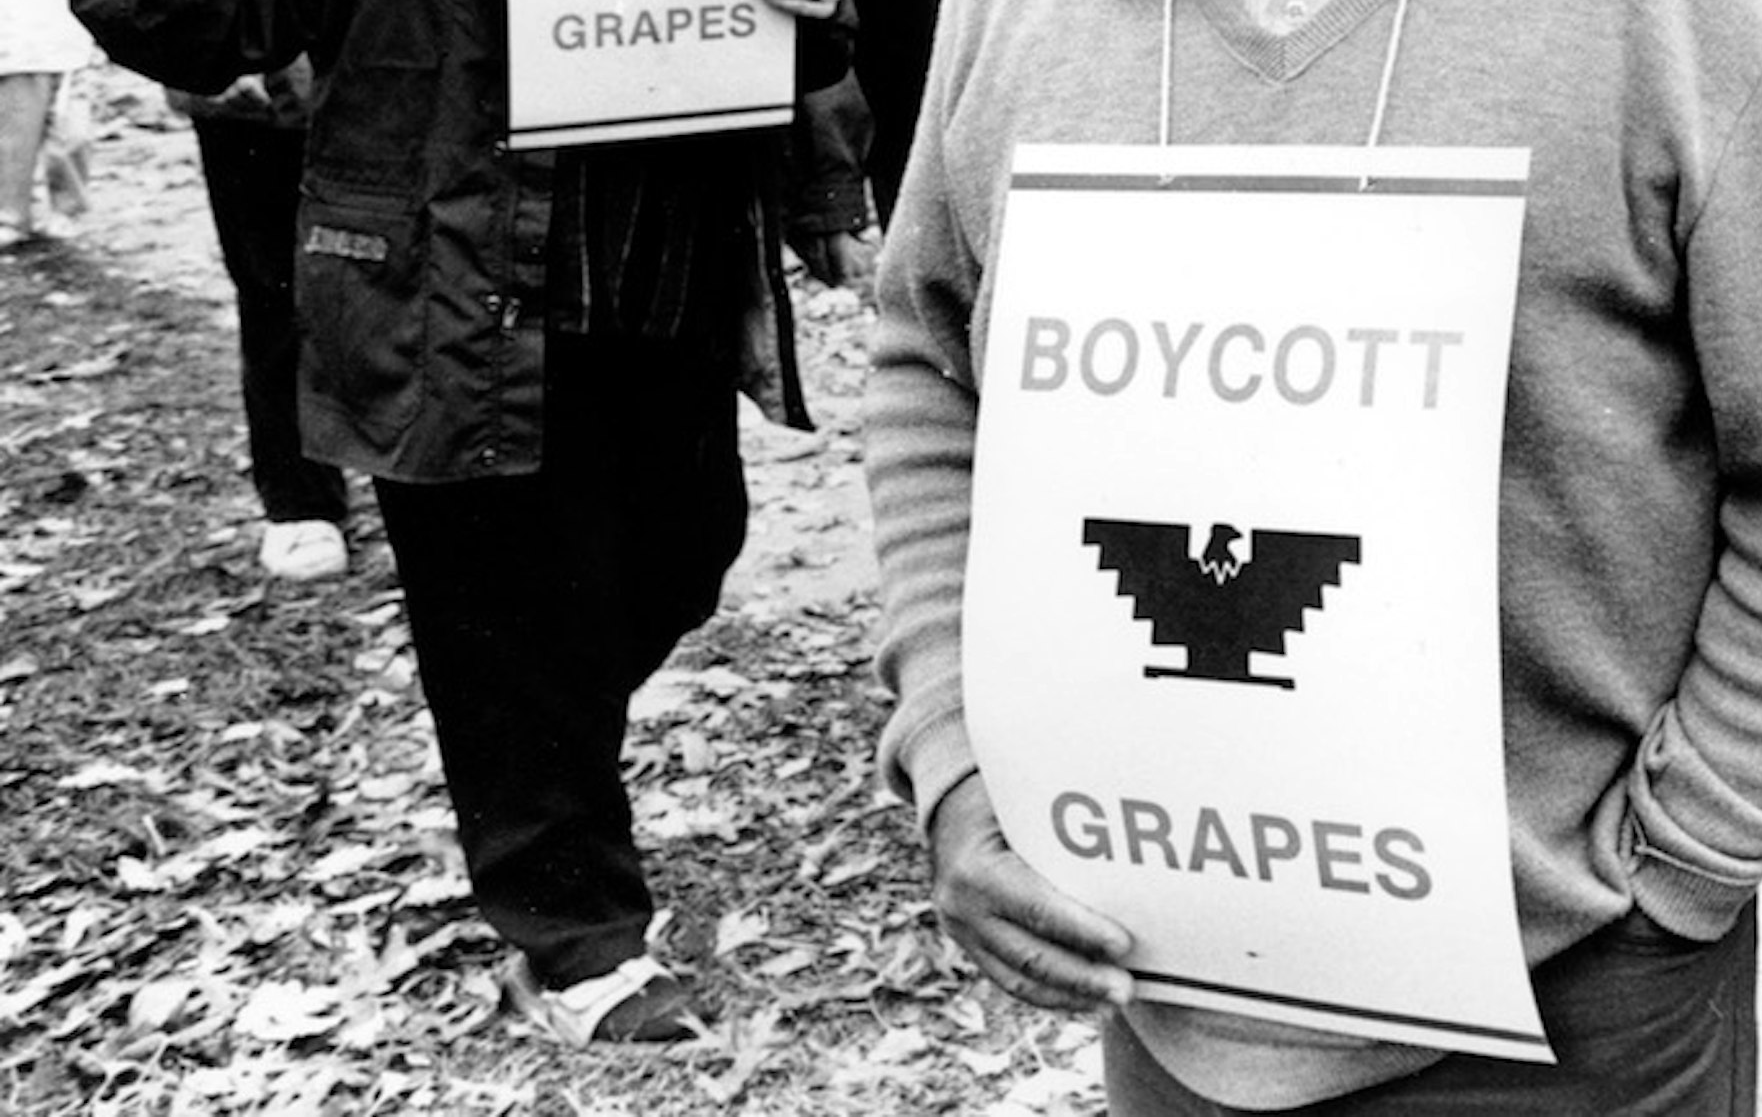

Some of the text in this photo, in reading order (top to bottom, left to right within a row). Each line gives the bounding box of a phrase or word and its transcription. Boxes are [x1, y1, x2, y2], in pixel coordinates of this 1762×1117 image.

[553, 2, 757, 51] GRAPES
[1019, 316, 1463, 409] BOYCOTT
[1050, 791, 1433, 900] GRAPES
